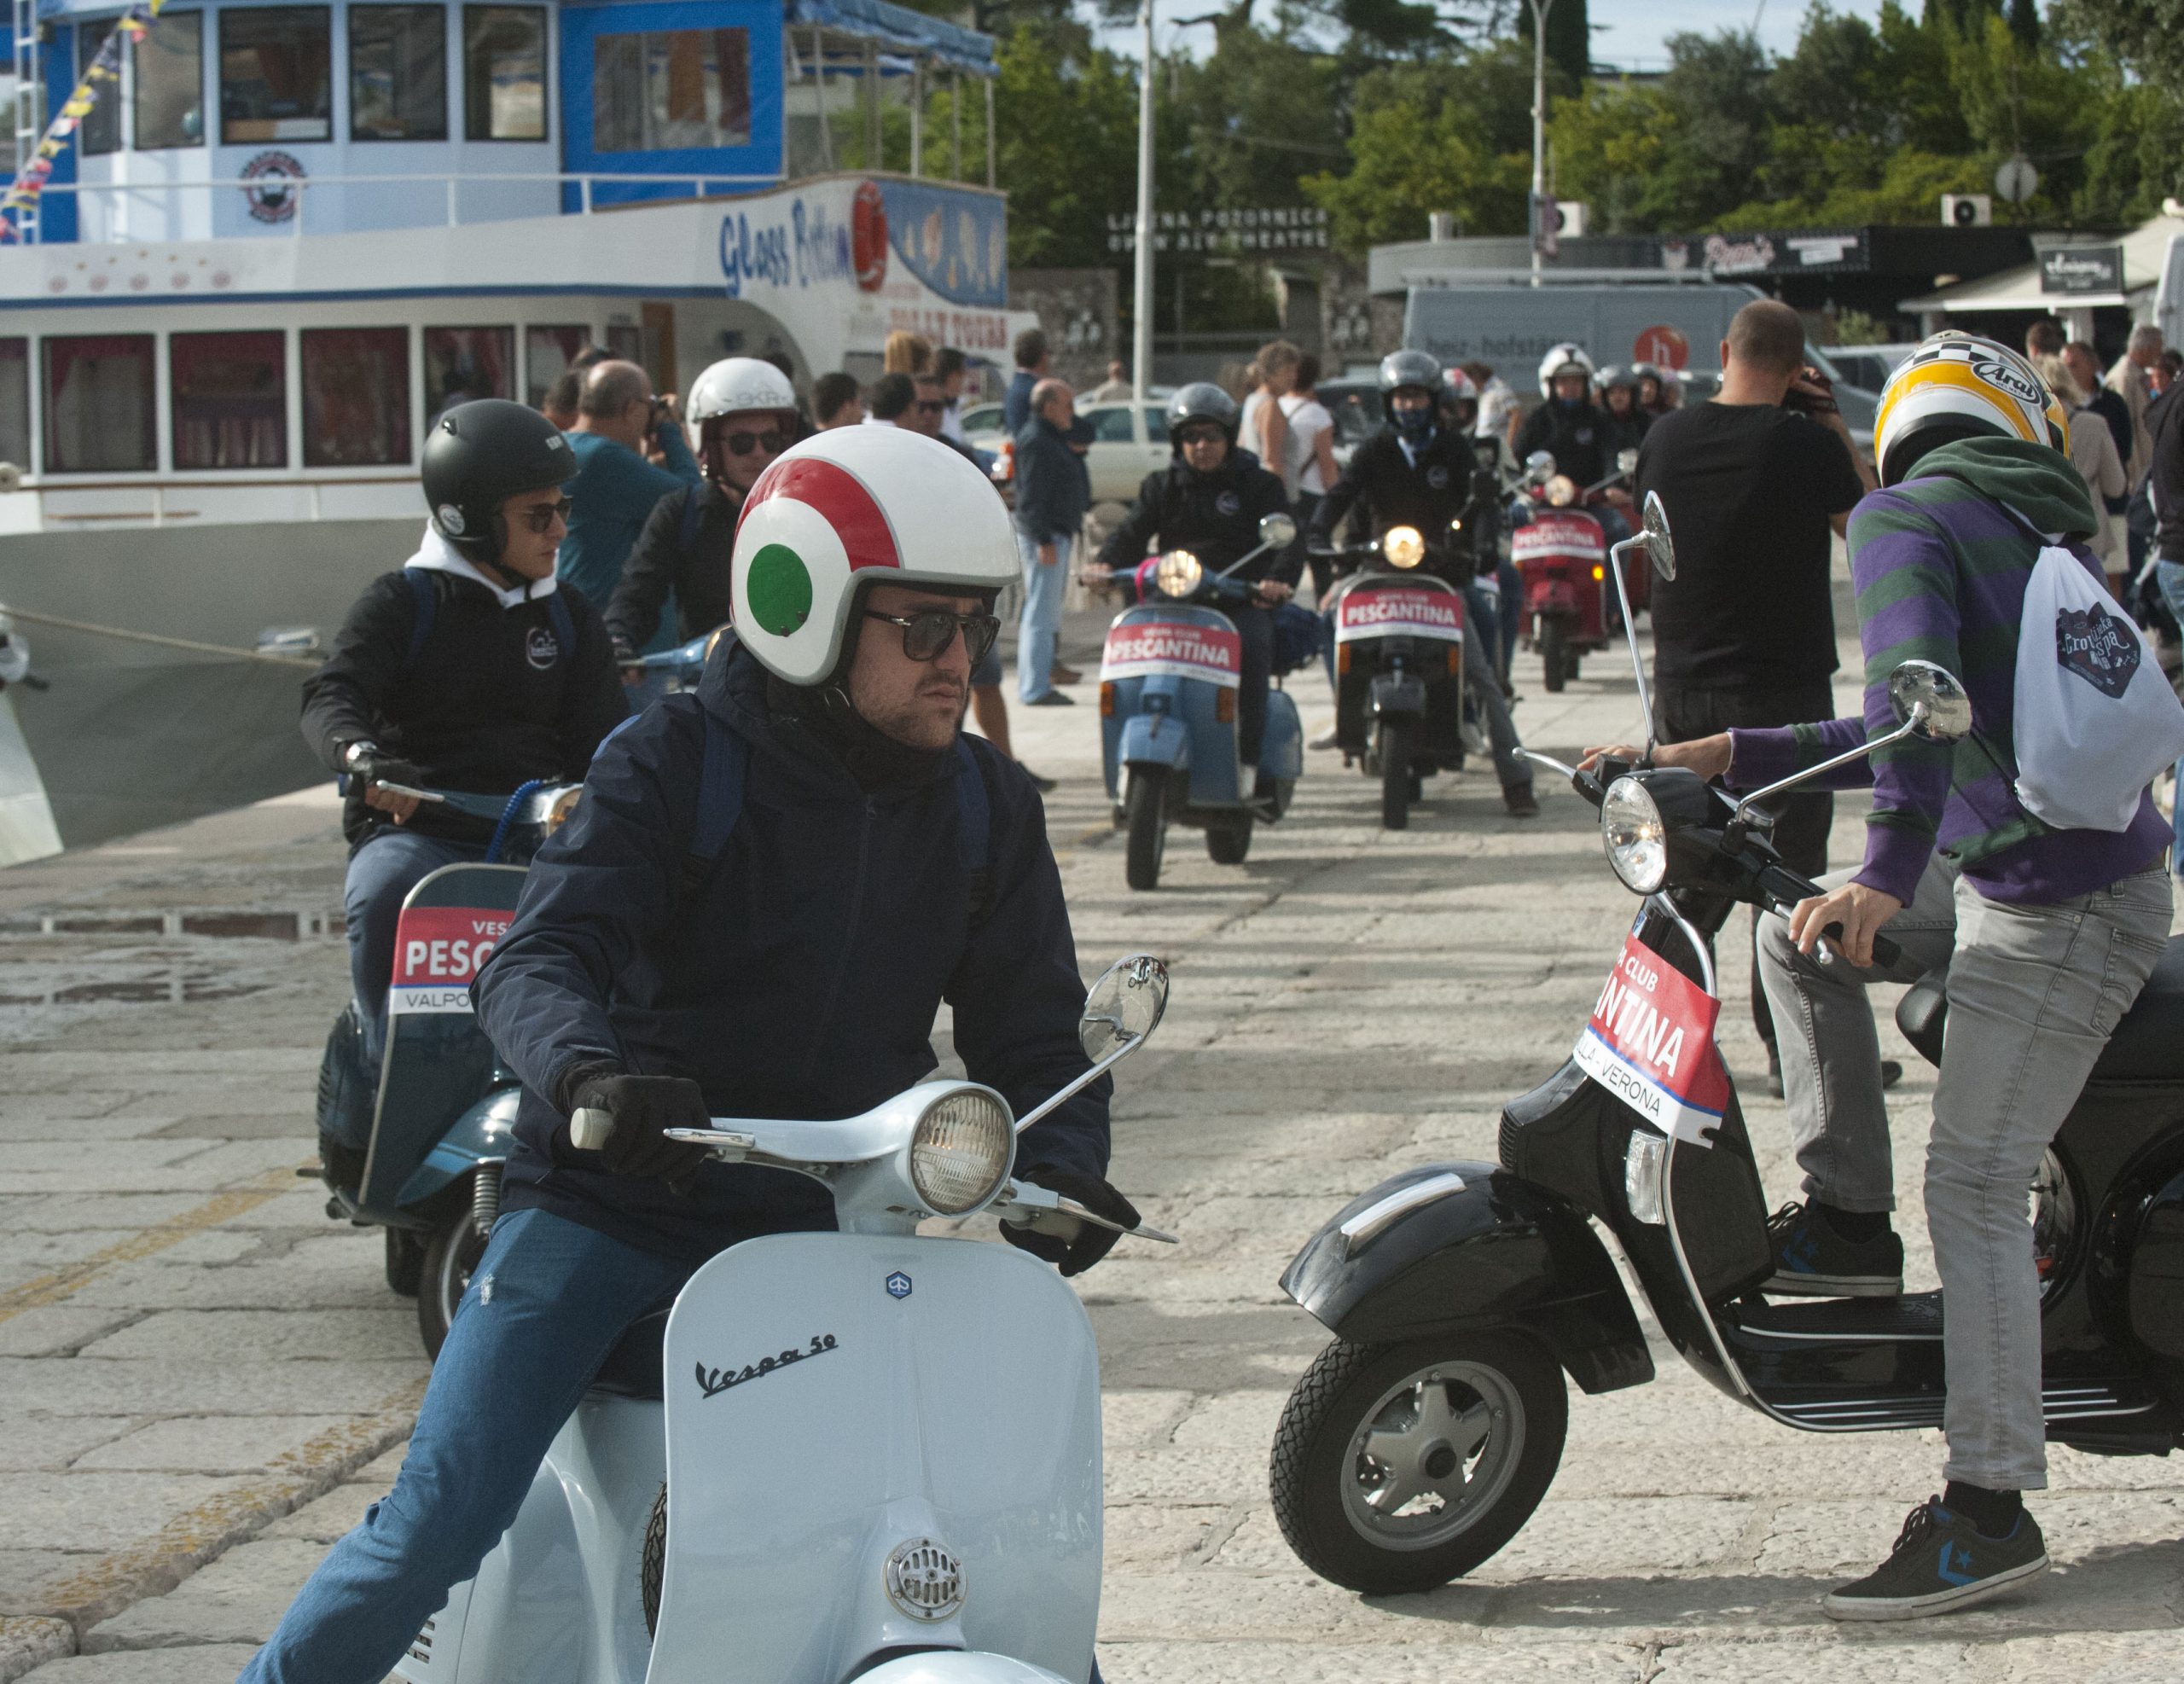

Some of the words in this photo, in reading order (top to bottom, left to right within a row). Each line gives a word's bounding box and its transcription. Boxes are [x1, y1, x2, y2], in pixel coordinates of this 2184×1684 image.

[1979, 366, 2034, 398] Arai
[1346, 601, 1456, 624] PESCANTINA
[1111, 638, 1230, 667] PESCANTINA
[472, 920, 513, 936] VES
[1625, 955, 1658, 993] CLUB
[1602, 1060, 1661, 1118] VERONA
[695, 1349, 806, 1397] Vespa
[810, 1333, 837, 1356] 50
